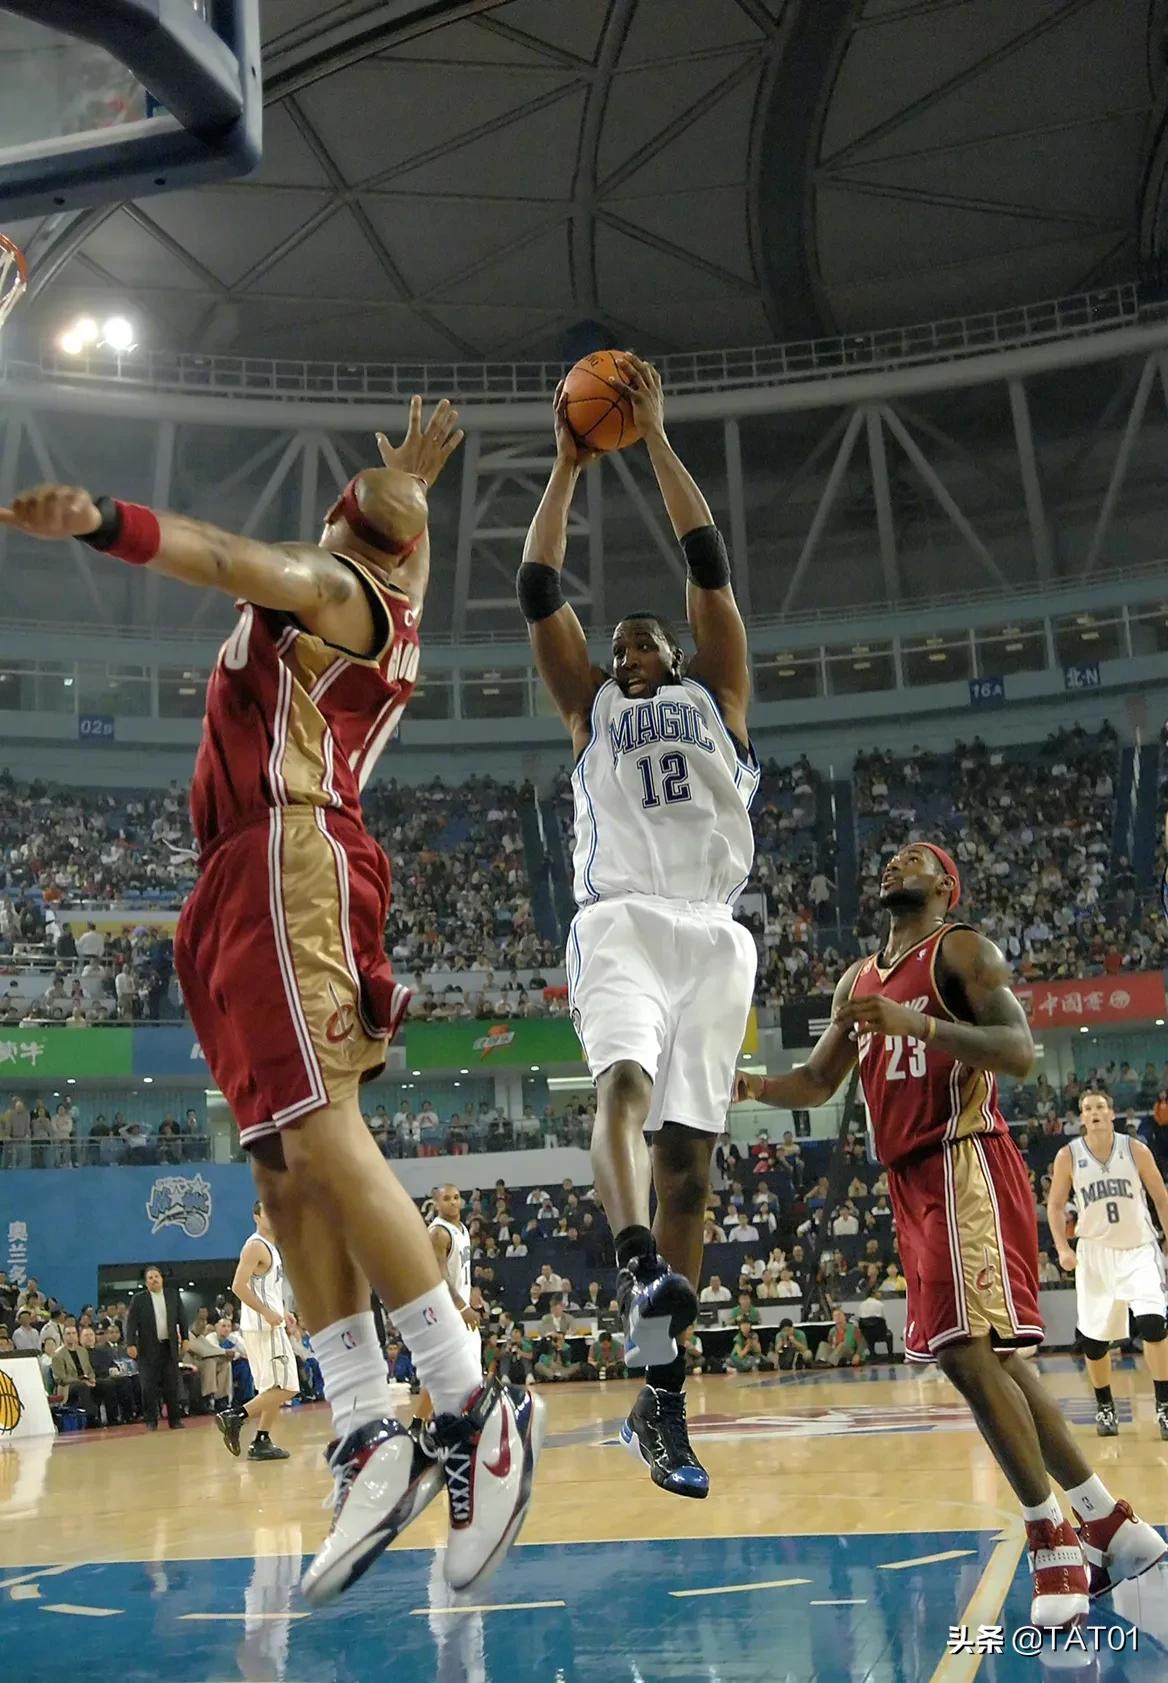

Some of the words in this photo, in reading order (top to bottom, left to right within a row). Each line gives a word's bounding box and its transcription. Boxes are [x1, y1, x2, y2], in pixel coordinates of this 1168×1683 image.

[609, 700, 716, 769] MAGIC
[637, 750, 692, 809] 12
[884, 1034, 928, 1081] 23
[1080, 1178, 1134, 1209] MAGIC
[1106, 1201, 1120, 1224] 8
